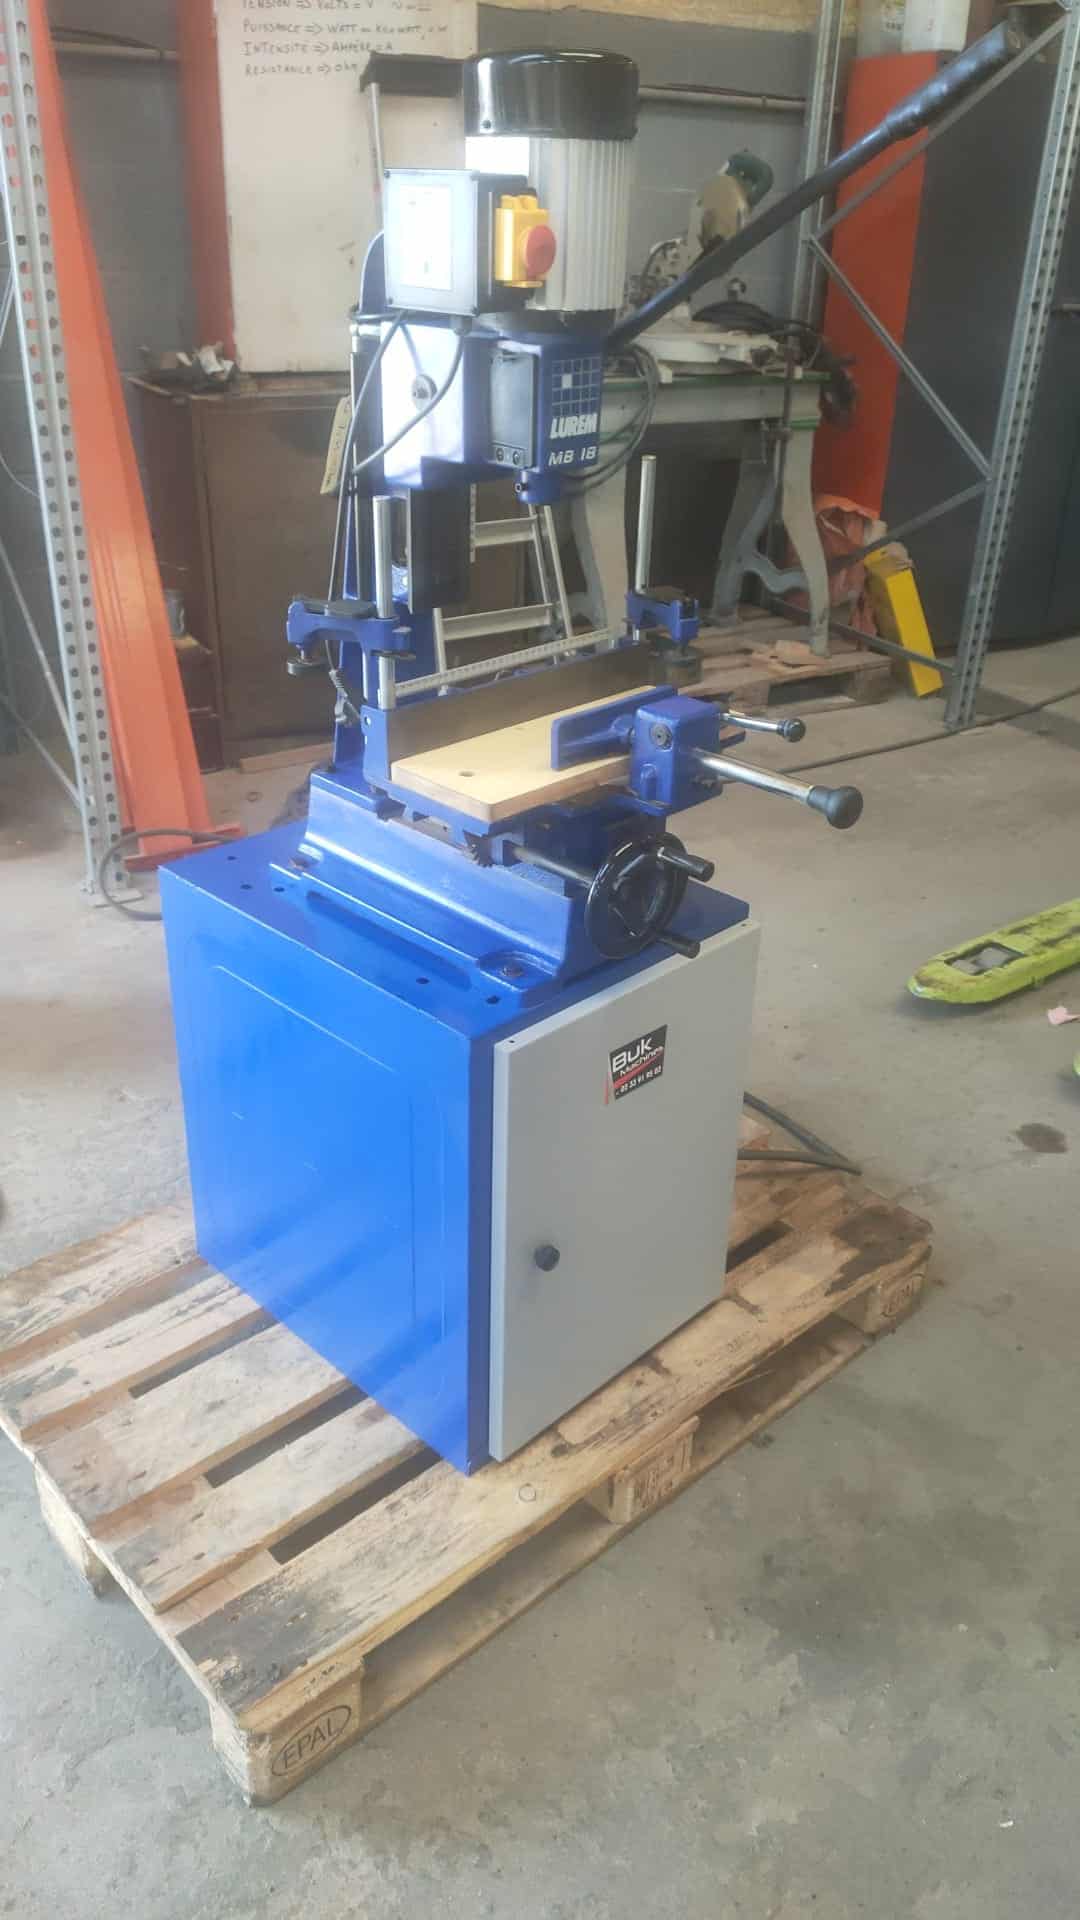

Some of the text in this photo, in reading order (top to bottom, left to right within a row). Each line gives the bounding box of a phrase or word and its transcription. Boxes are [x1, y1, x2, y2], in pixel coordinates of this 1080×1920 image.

[550, 413, 598, 440] LUREM
[548, 450, 576, 467] MB
[283, 1717, 339, 1770] EPAL
